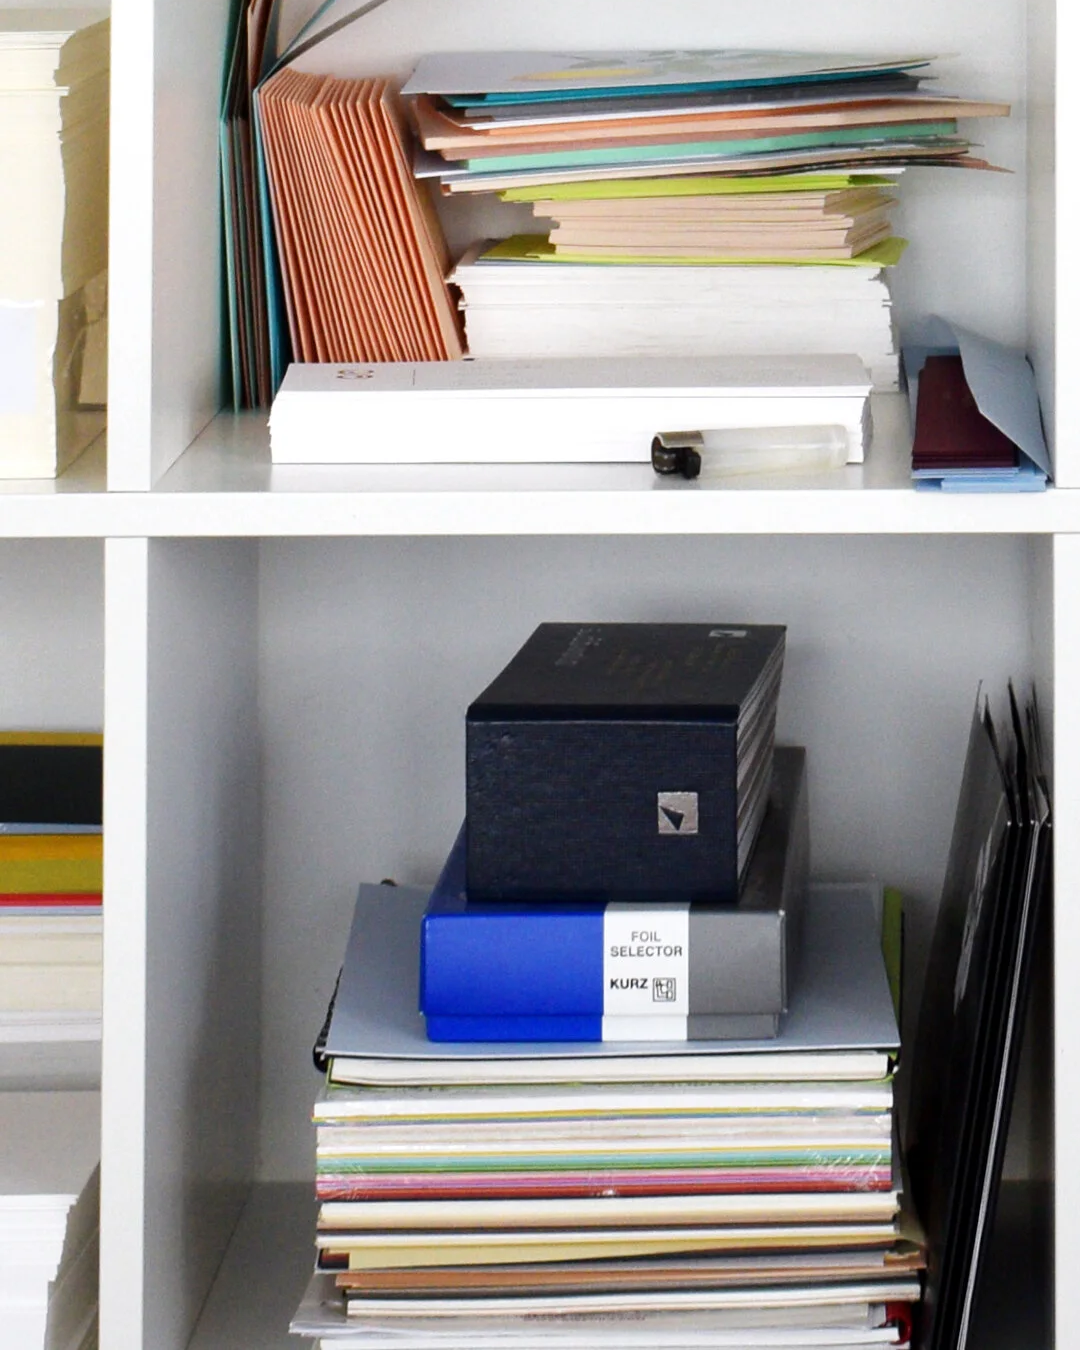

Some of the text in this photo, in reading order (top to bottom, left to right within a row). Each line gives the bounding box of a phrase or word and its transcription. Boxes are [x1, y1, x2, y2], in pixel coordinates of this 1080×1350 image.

[631, 931, 661, 942] FOIL
[610, 945, 682, 957] SELECTOR
[610, 978, 648, 990] KURZ
